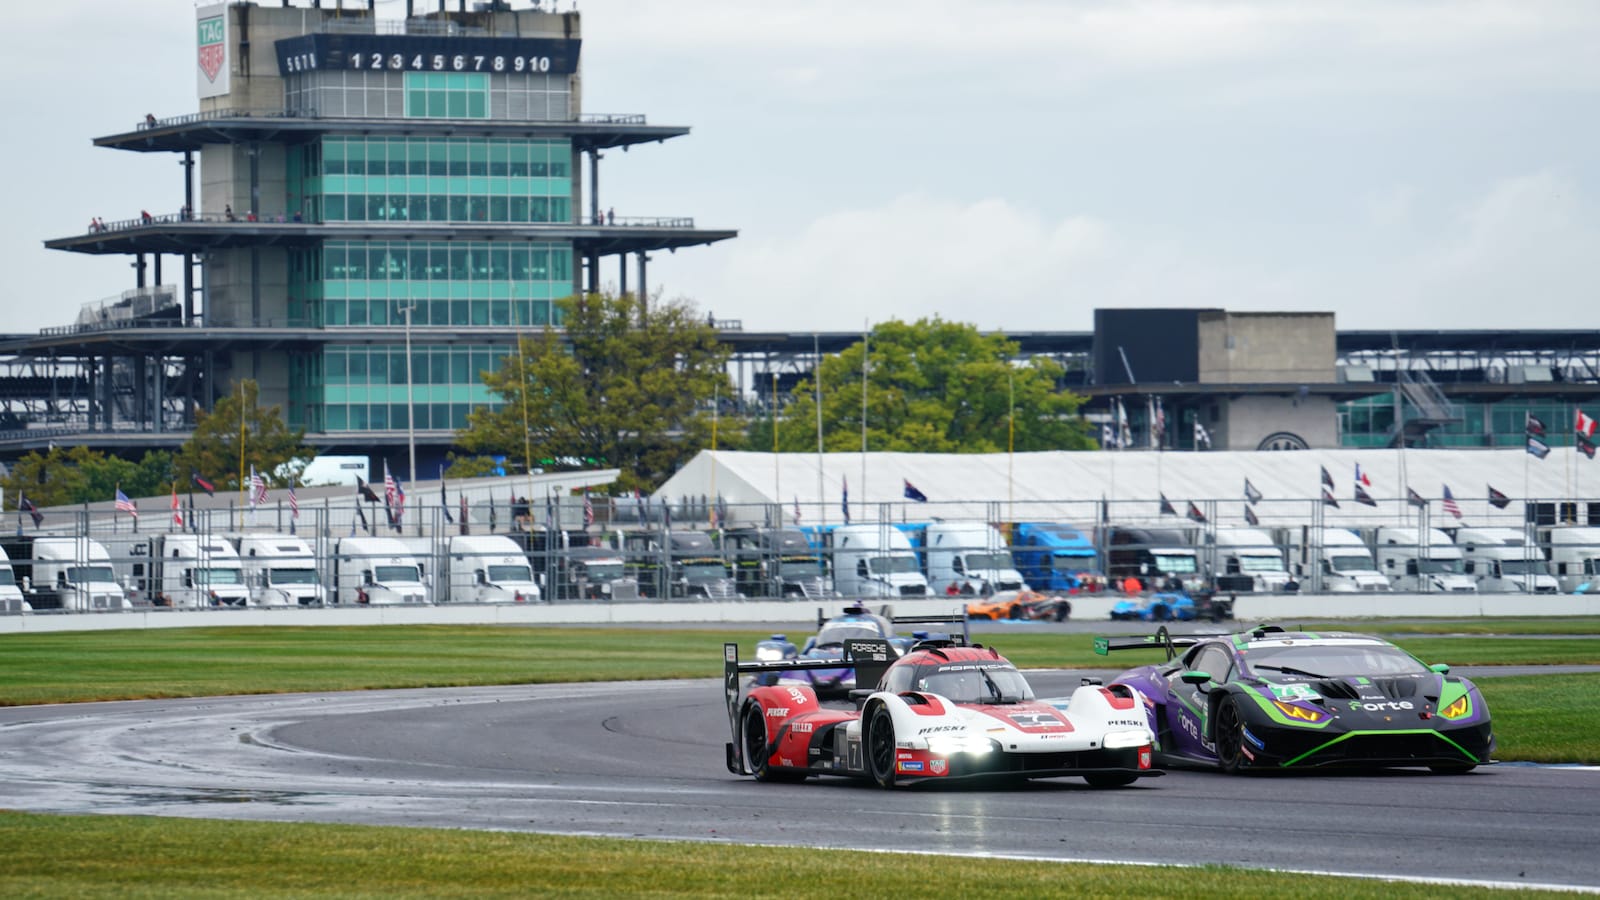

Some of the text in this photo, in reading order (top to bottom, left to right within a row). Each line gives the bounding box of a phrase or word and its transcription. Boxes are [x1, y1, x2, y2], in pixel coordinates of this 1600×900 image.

[200, 20, 223, 43] TAG
[287, 57, 293, 72] 5
[352, 53, 550, 72] 1 2 3 4 5 6 7 8 9 10
[851, 642, 886, 653] PORSCHE
[1348, 700, 1414, 712] Forte
[918, 725, 966, 735] PENSKE
[1178, 708, 1198, 740] Forte
